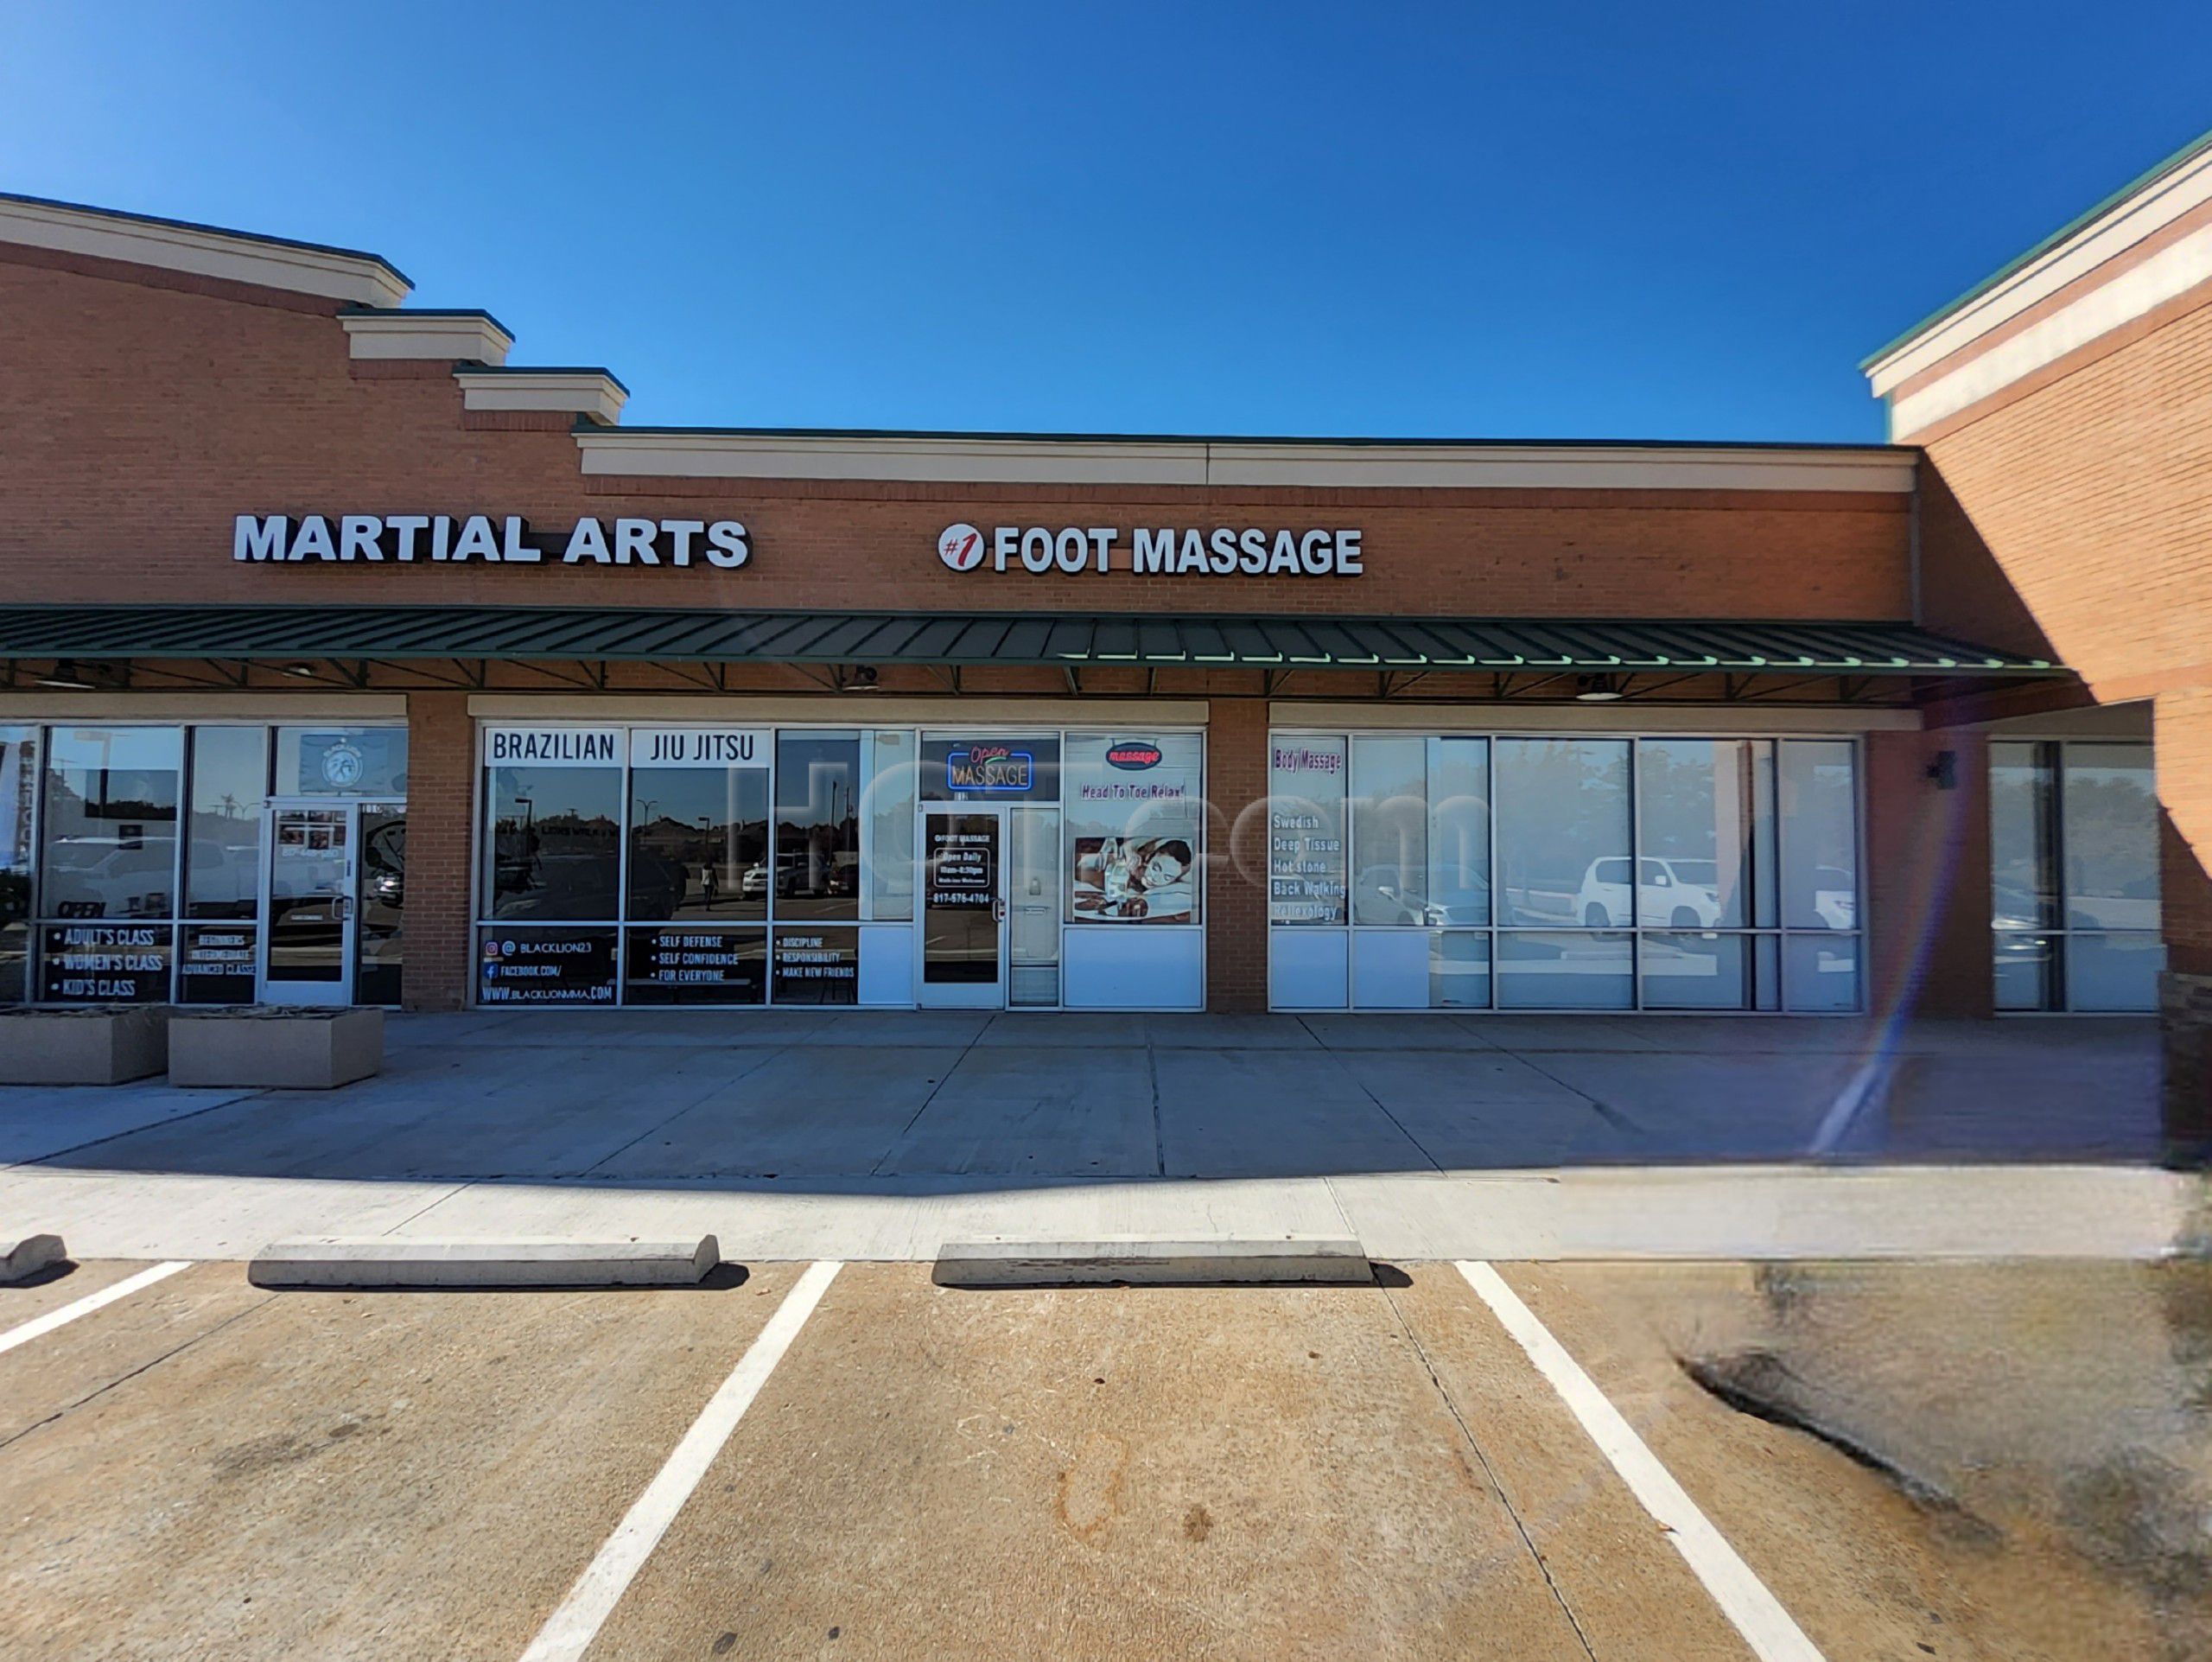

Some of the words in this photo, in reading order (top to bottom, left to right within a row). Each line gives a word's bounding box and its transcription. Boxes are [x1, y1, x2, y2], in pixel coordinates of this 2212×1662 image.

[233, 515, 541, 562] MARTIAL
[563, 517, 749, 569] ARTS
[943, 532, 977, 567] #1
[995, 526, 1117, 573] FOOT
[1132, 528, 1363, 574] MASSAGE
[493, 733, 615, 761] BRAZILIAN
[650, 734, 684, 761] JIU
[693, 734, 754, 761] JITSU
[970, 745, 1009, 764] Open
[1109, 750, 1160, 765] massage
[1274, 749, 1298, 774] Body
[1300, 749, 1342, 774] Massage
[951, 765, 1028, 786] MASSAGE
[1082, 785, 1108, 799] Head
[1114, 785, 1124, 799] To
[1128, 785, 1147, 799] Toe
[1274, 815, 1319, 829] Swedish
[1274, 837, 1300, 854] Deep
[1305, 837, 1340, 851] Tissue
[1274, 860, 1294, 874] Hot
[1274, 881, 1300, 895] Back
[1303, 880, 1346, 900] Walking
[1274, 903, 1338, 922] Reflexology
[64, 928, 115, 946] ADULT'S
[117, 929, 155, 946] CLASS
[659, 936, 682, 948] SELF
[683, 936, 723, 948] DEFENSE
[783, 938, 823, 948] DISCIPLINE
[521, 941, 592, 953] BLACKLION23
[64, 953, 124, 971] WOMEN'S
[124, 954, 163, 971] CLASS
[659, 953, 681, 965] SELF
[683, 953, 739, 965] CONFIDENCE
[783, 952, 841, 963] RESPONSIBILITY
[658, 970, 676, 982] FOR
[678, 970, 725, 982] EVERYONE
[783, 967, 804, 977] MAKE
[804, 967, 822, 977] NEW
[823, 967, 855, 977] FRIENDS
[63, 978, 96, 996] KID'S
[99, 979, 136, 997] CLASS
